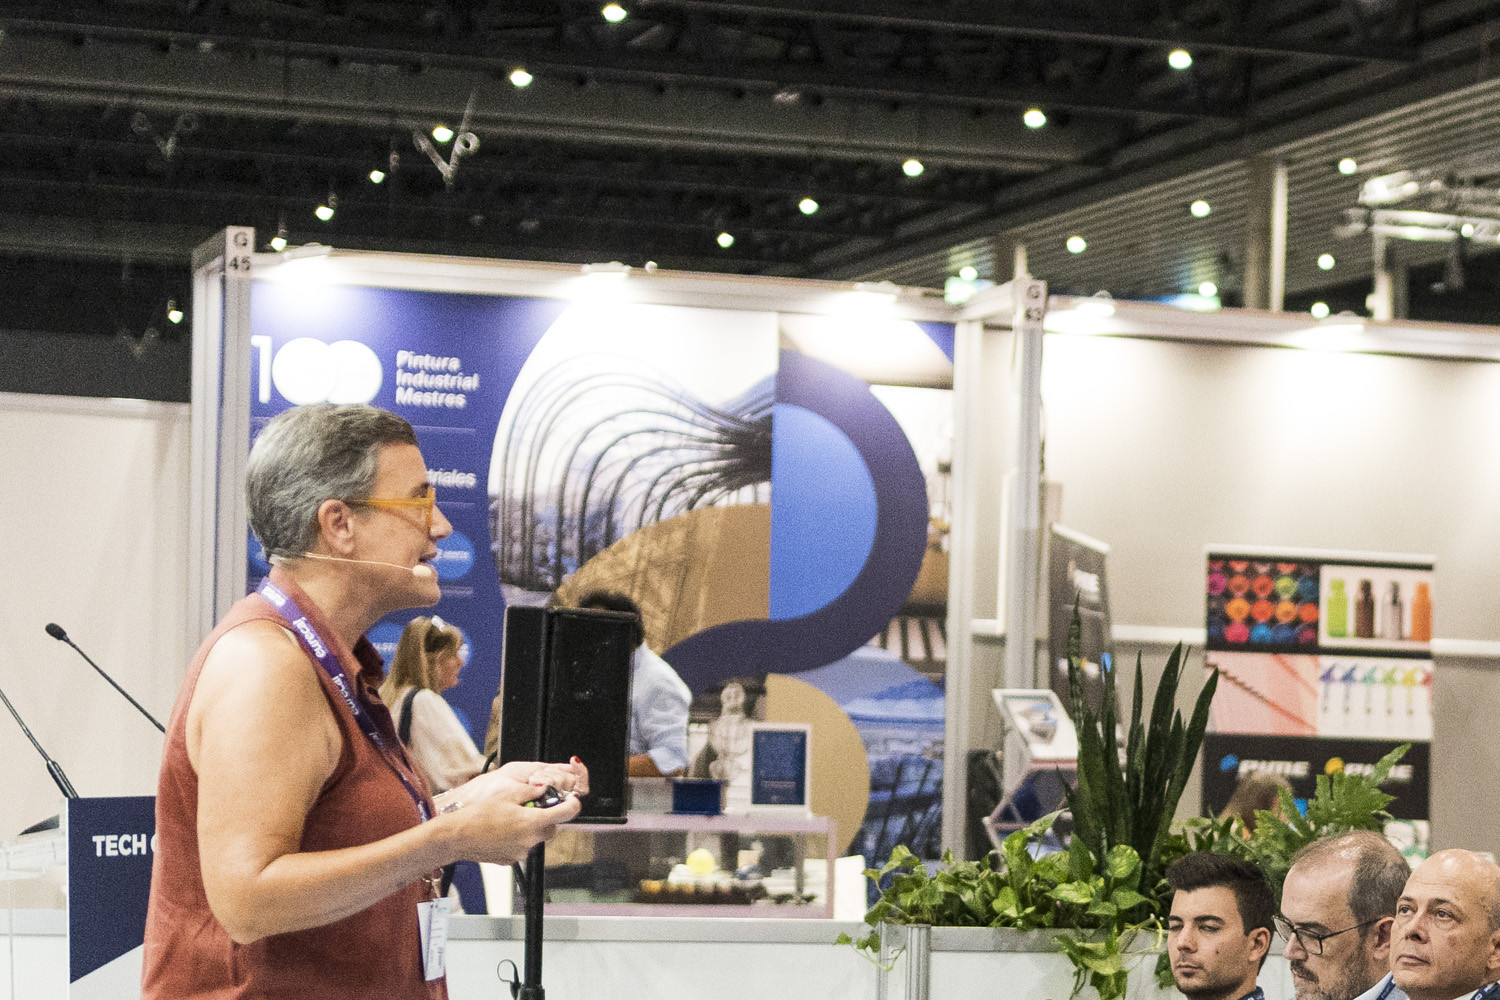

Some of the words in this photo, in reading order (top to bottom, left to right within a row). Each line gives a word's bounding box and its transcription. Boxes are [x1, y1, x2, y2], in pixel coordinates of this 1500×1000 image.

[396, 350, 460, 372] Pintura
[396, 368, 479, 391] Industrial
[396, 386, 467, 409] Mestres
[92, 834, 147, 857] TECH
